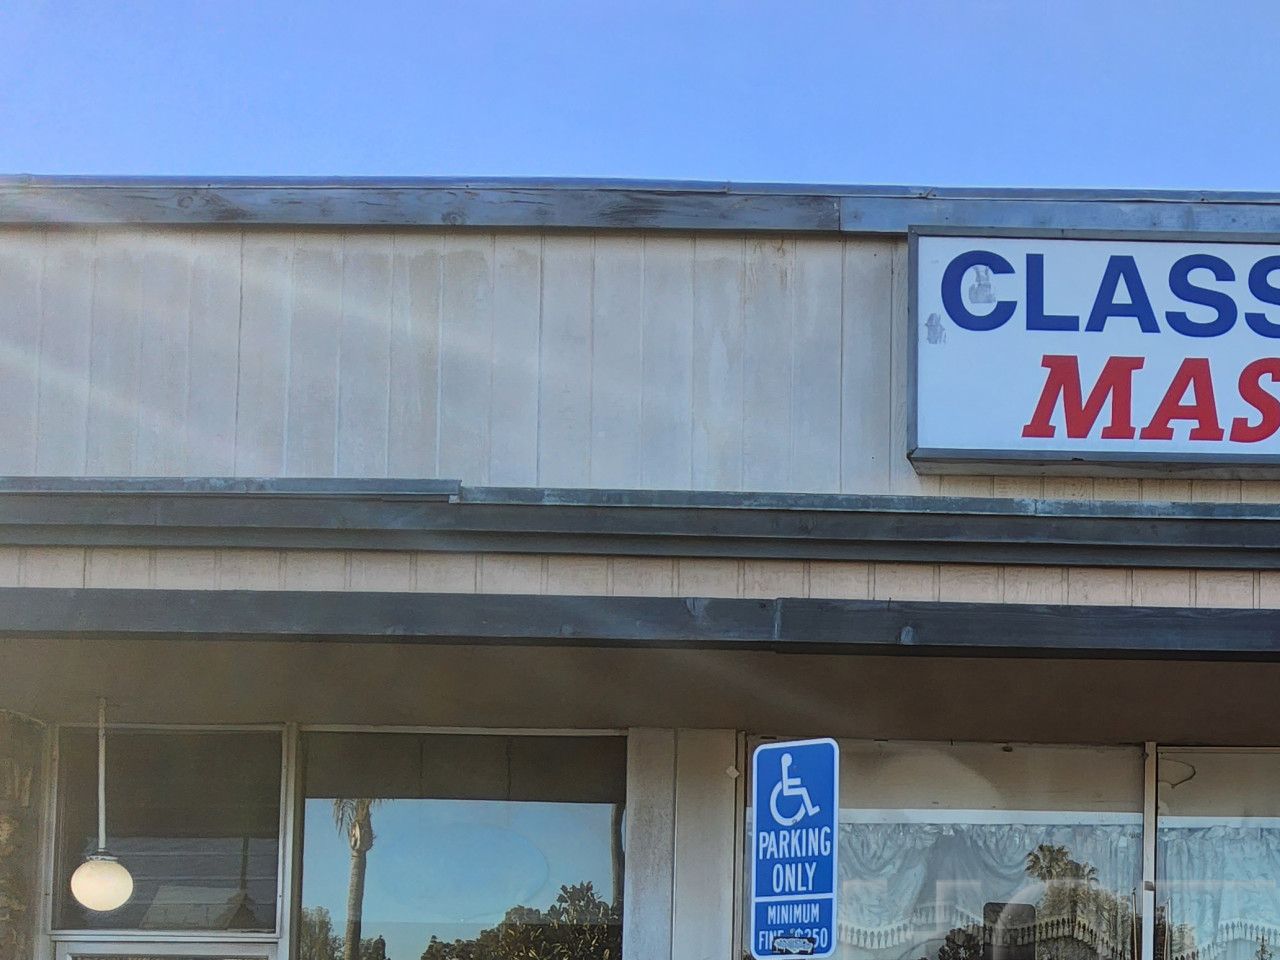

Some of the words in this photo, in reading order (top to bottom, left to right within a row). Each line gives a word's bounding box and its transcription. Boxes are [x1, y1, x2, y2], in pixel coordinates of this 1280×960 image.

[758, 826, 832, 860] PARKING
[772, 861, 817, 893] ONLY
[767, 902, 820, 925] MINIMUM
